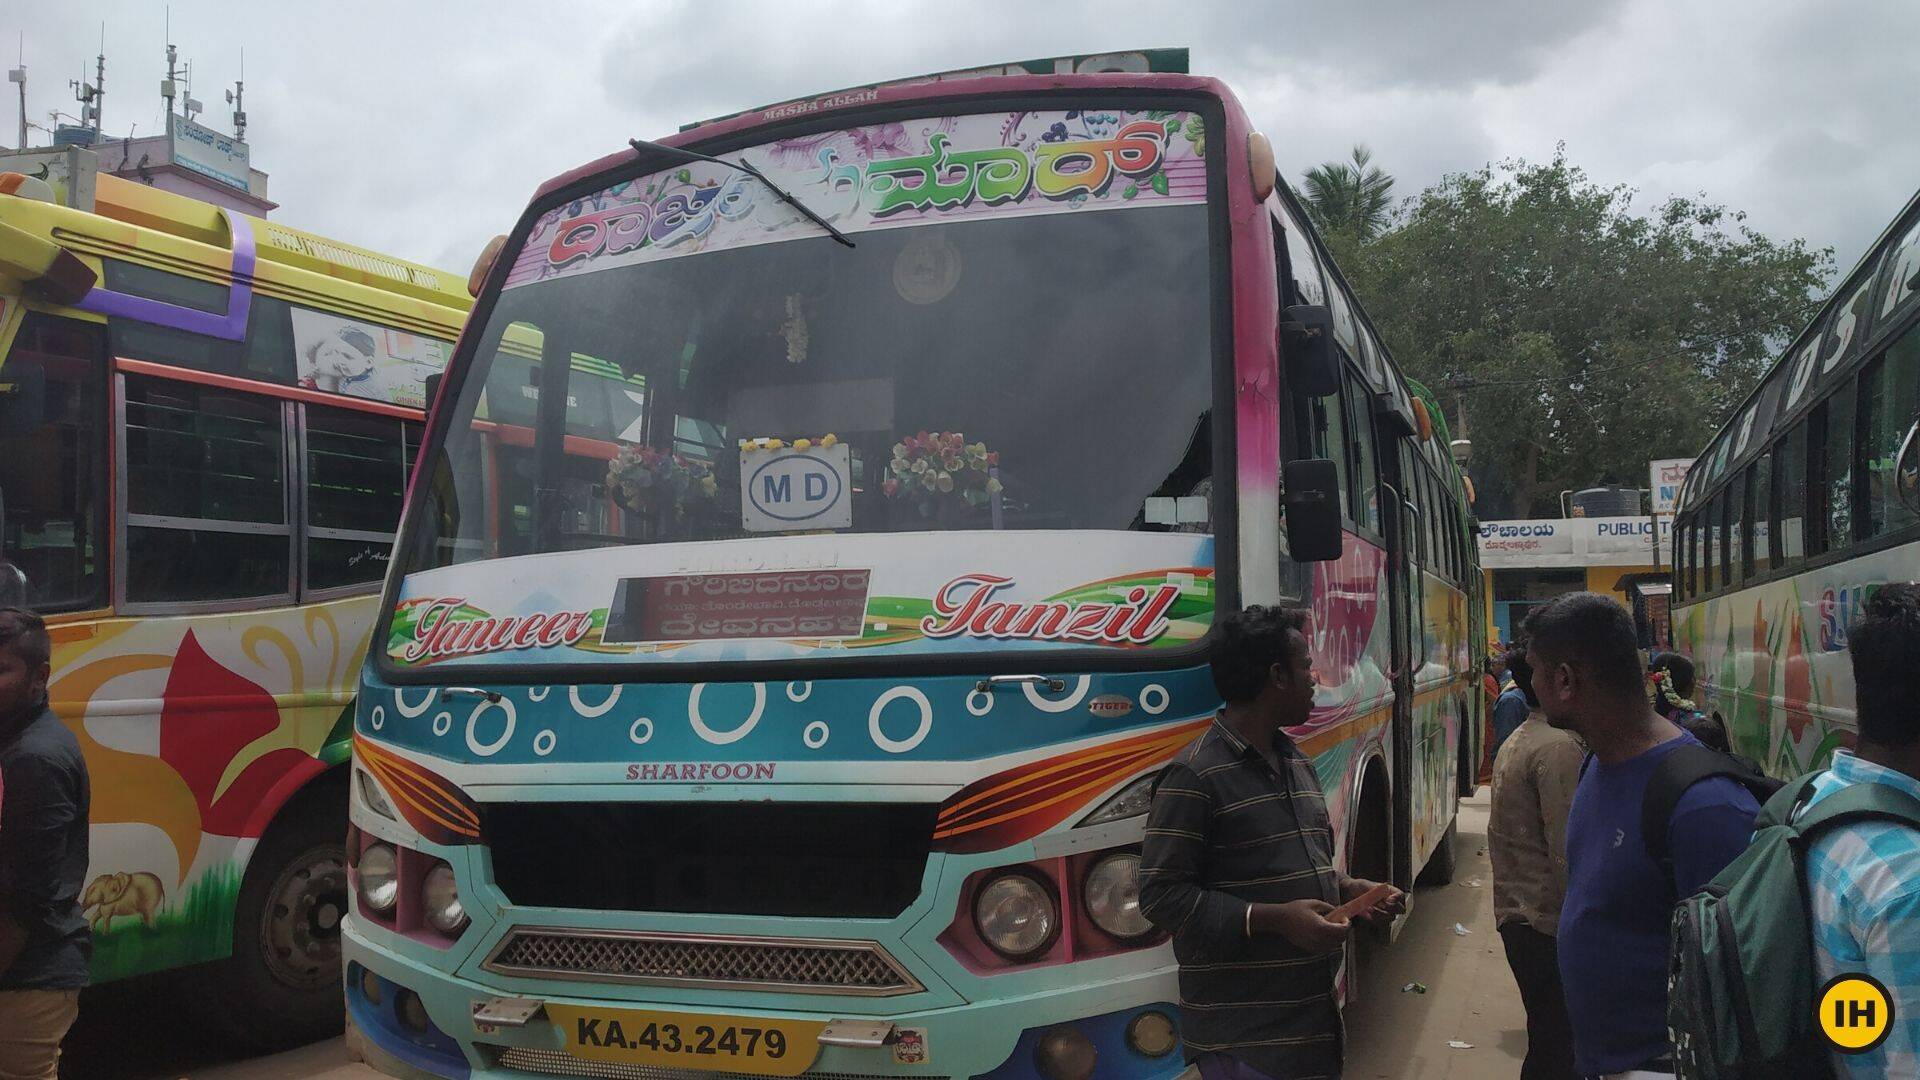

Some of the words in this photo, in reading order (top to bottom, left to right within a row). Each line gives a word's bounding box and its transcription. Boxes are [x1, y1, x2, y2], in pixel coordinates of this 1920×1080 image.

[762, 101, 819, 121] MASHA
[823, 90, 879, 109] ALLAH
[1598, 522, 1653, 537] PUBLIC
[920, 571, 1182, 644] Tanzil
[404, 597, 593, 662] Tanveer
[1092, 702, 1130, 711] TIGER
[626, 763, 777, 780] SHARFOON
[577, 1017, 787, 1059] KA.43.2479
